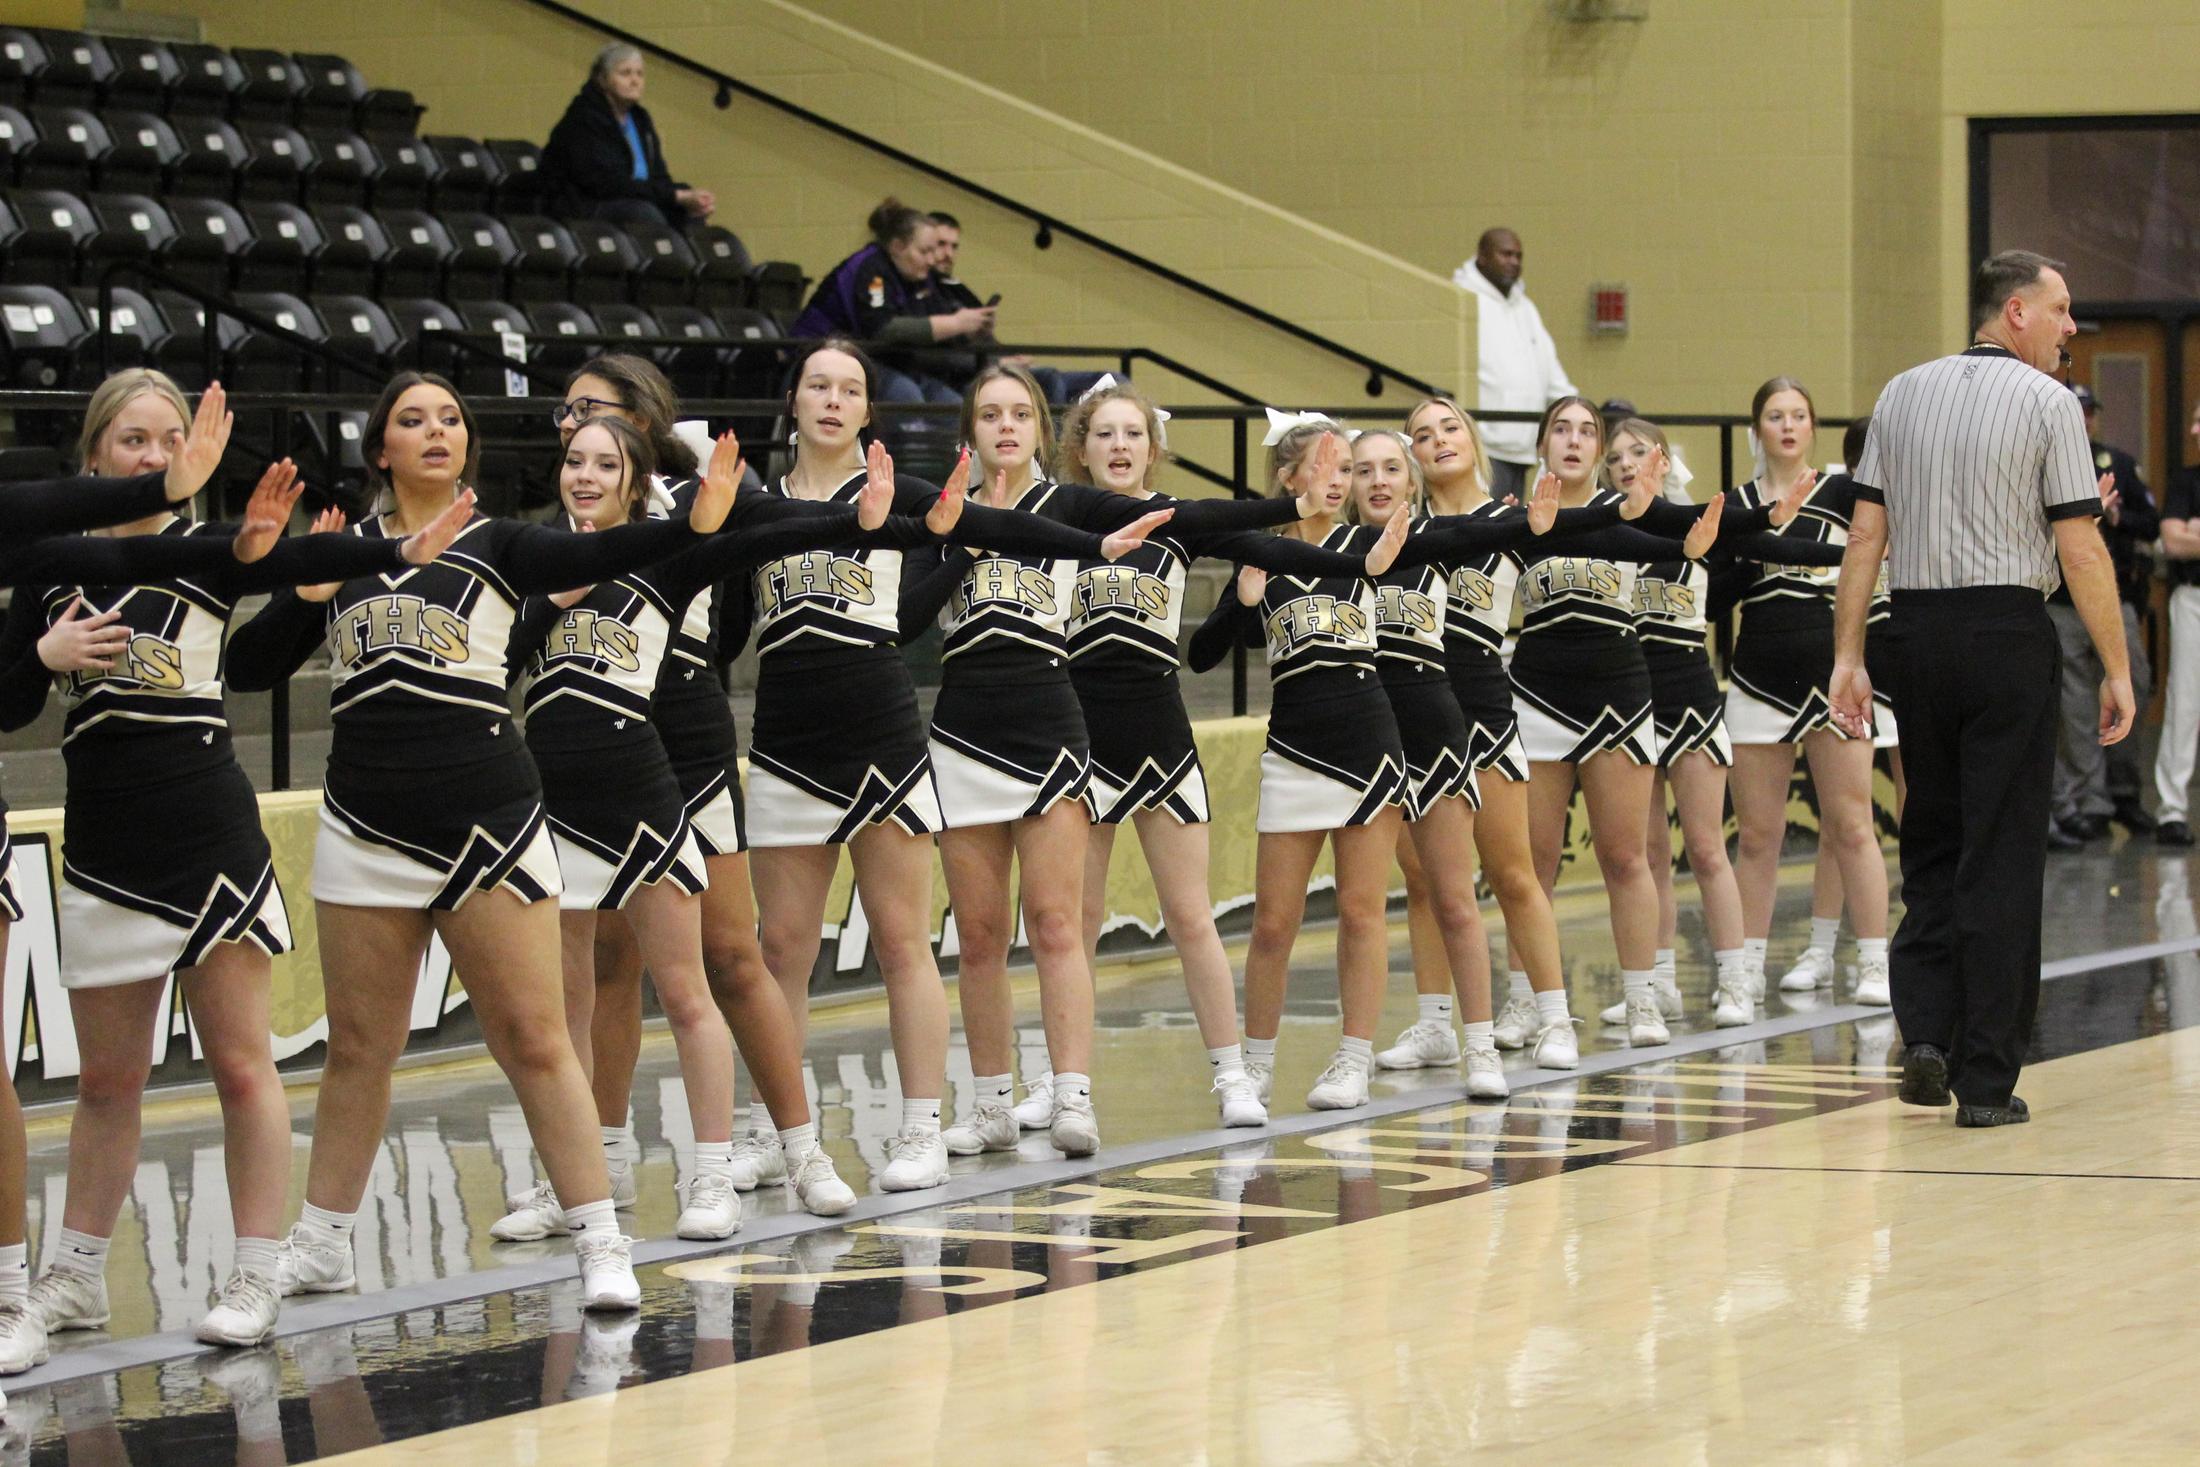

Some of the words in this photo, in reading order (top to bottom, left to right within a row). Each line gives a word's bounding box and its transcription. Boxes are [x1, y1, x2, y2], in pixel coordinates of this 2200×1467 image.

[753, 551, 876, 616] THS
[1376, 587, 1436, 633] HS
[1632, 578, 1697, 619] HS
[331, 594, 470, 668] THS
[527, 610, 640, 673] HS
[1266, 597, 1370, 656] THS
